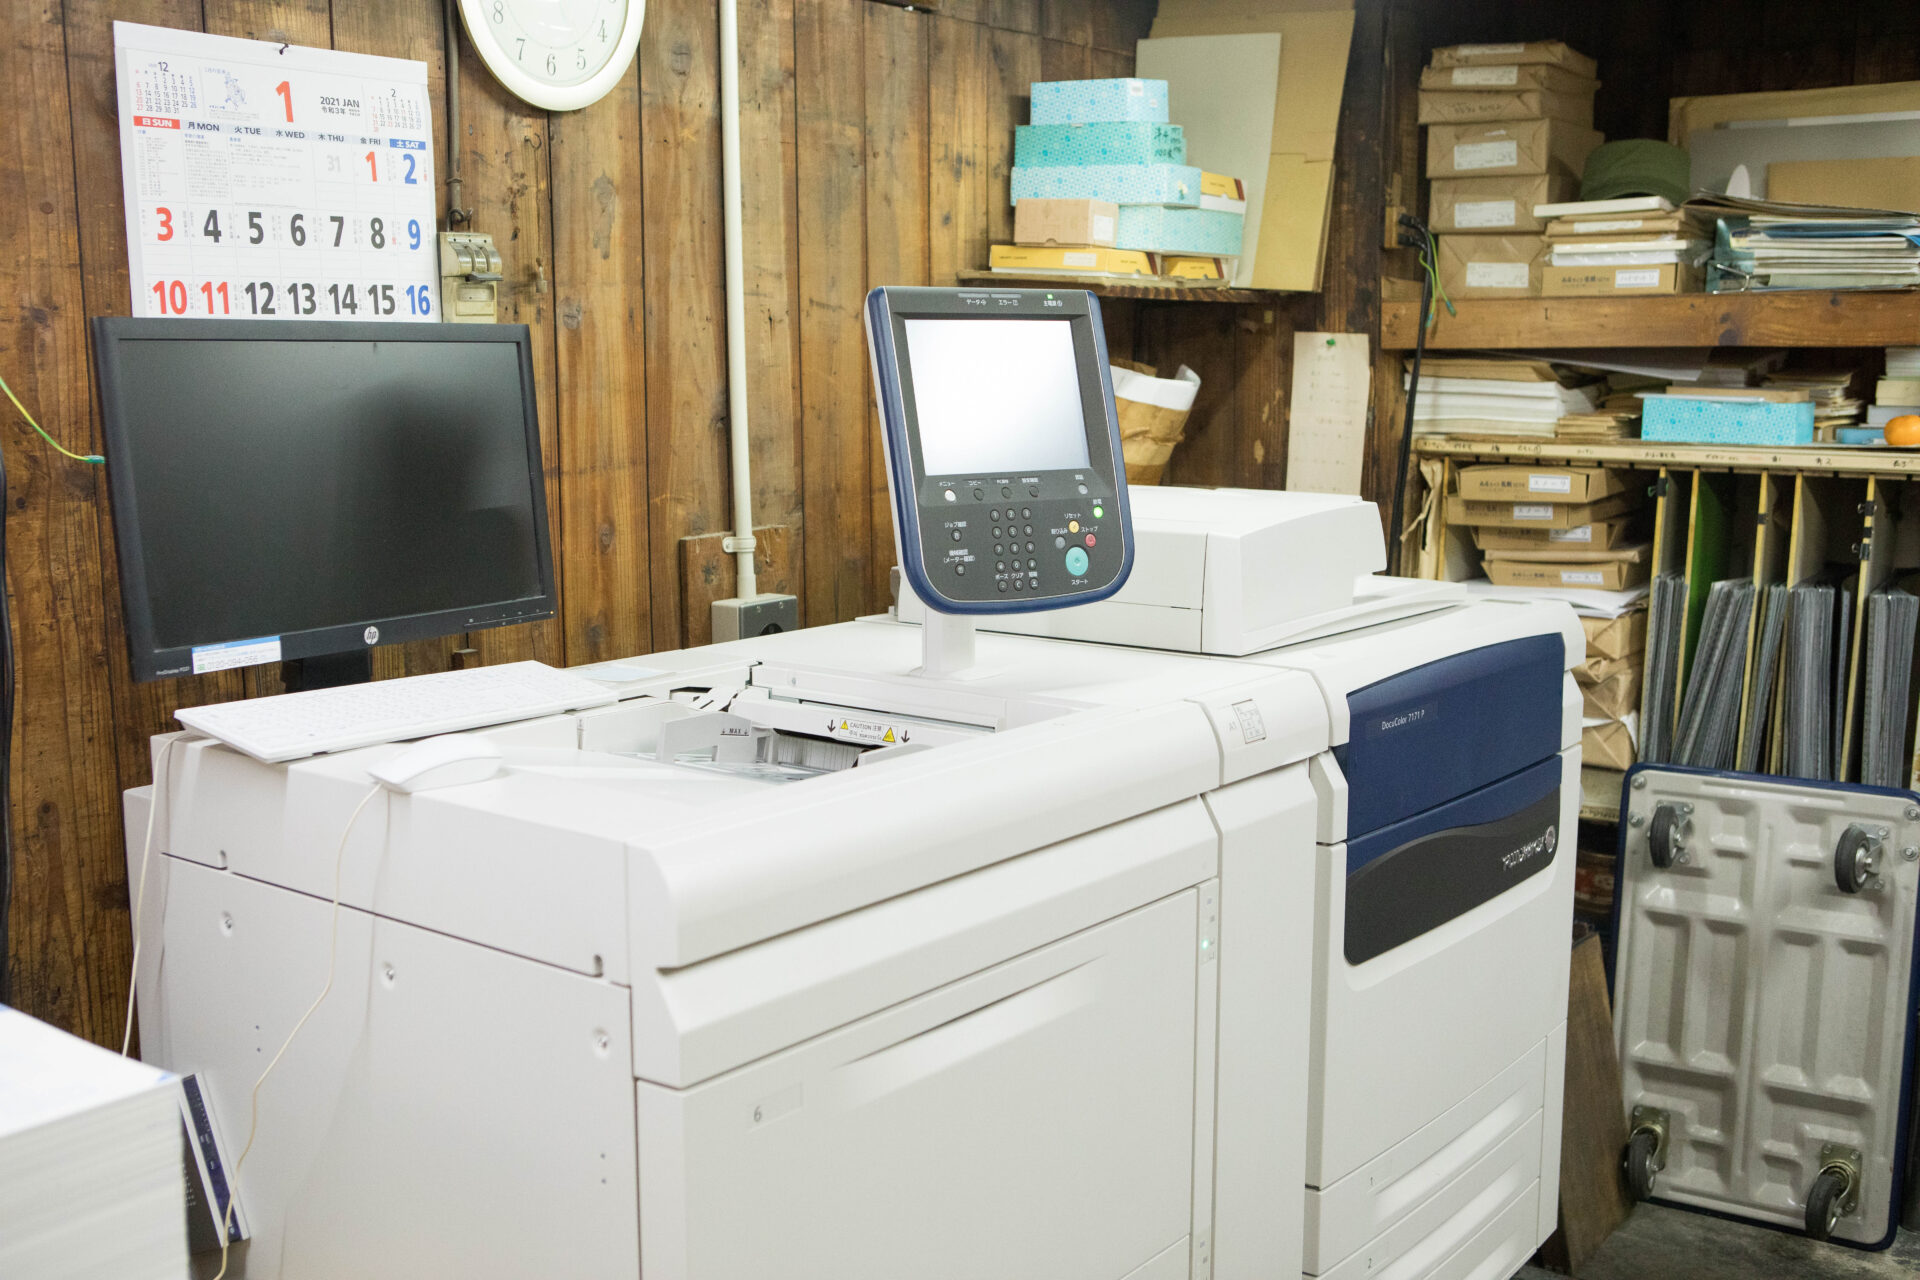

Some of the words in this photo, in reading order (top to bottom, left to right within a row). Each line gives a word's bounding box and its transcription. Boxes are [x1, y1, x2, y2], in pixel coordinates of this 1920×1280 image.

[493, 0, 504, 24] 8
[598, 19, 608, 43] 4
[516, 38, 526, 60] 7
[158, 62, 169, 72] 12
[546, 53, 556, 76] 6
[576, 48, 586, 70] 5
[275, 80, 294, 123] 1
[391, 88, 396, 98] 2
[320, 96, 340, 106] 2021
[343, 99, 360, 108] JAN
[322, 106, 346, 115] 令和3年
[152, 119, 172, 127] SUN
[197, 123, 220, 132] MON
[244, 127, 261, 135] TUE
[285, 131, 305, 139] WED
[406, 141, 420, 149] SAT
[327, 155, 341, 172] 31
[365, 151, 377, 182] 1
[403, 153, 417, 184] 2
[156, 207, 174, 242] 3
[203, 209, 222, 243] 4
[248, 212, 264, 244] 5
[290, 214, 306, 246] 6
[330, 216, 344, 247] 7
[370, 217, 386, 250] 8
[407, 219, 421, 250] 9
[152, 280, 188, 315] 10
[200, 281, 230, 314] 11
[245, 282, 276, 315] 12
[287, 282, 317, 315] 13
[328, 283, 358, 315] 14
[368, 284, 396, 315] 15
[406, 284, 431, 315] 16
[366, 627, 378, 644] hp
[850, 722, 872, 731] CAUTION
[1382, 716, 1407, 730] DocuColor
[1421, 710, 1425, 719] P
[754, 1104, 762, 1122] 6
